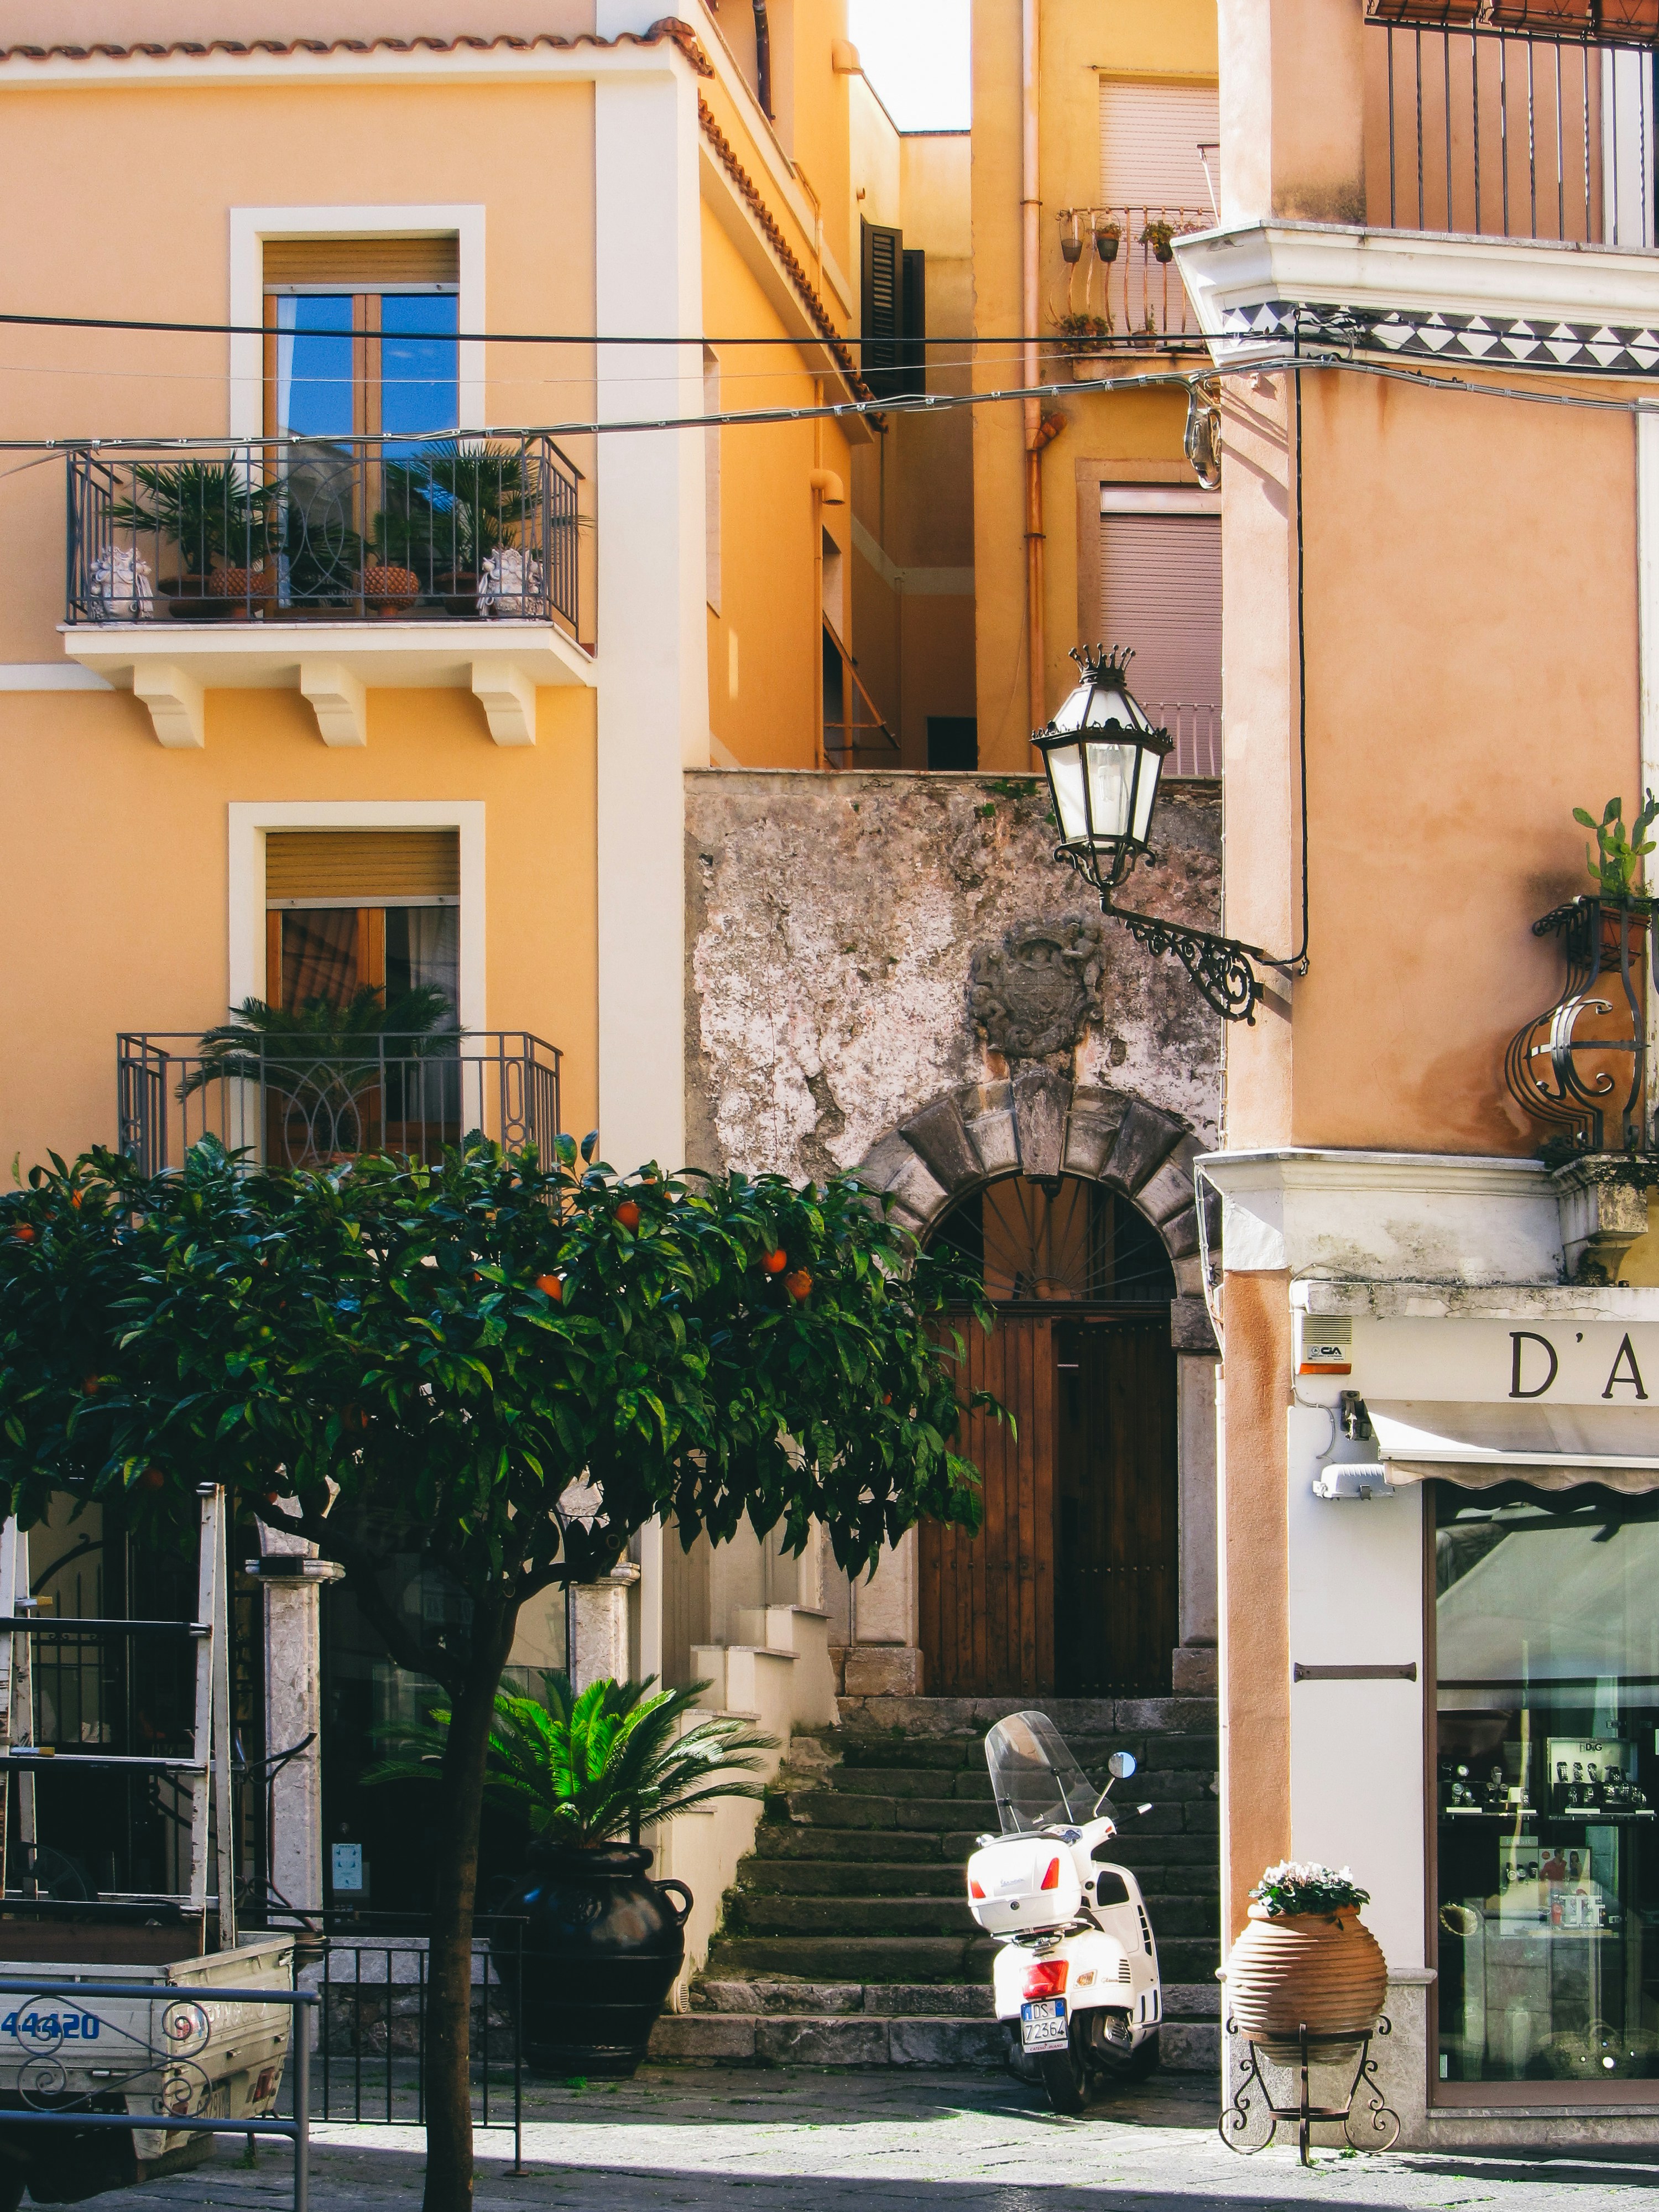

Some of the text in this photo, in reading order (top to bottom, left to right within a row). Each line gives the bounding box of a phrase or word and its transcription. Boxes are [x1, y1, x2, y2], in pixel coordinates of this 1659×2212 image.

[1034, 2004, 1048, 2019] DS
[1, 2012, 100, 2039] 44420
[1025, 2020, 1065, 2041] 72364
